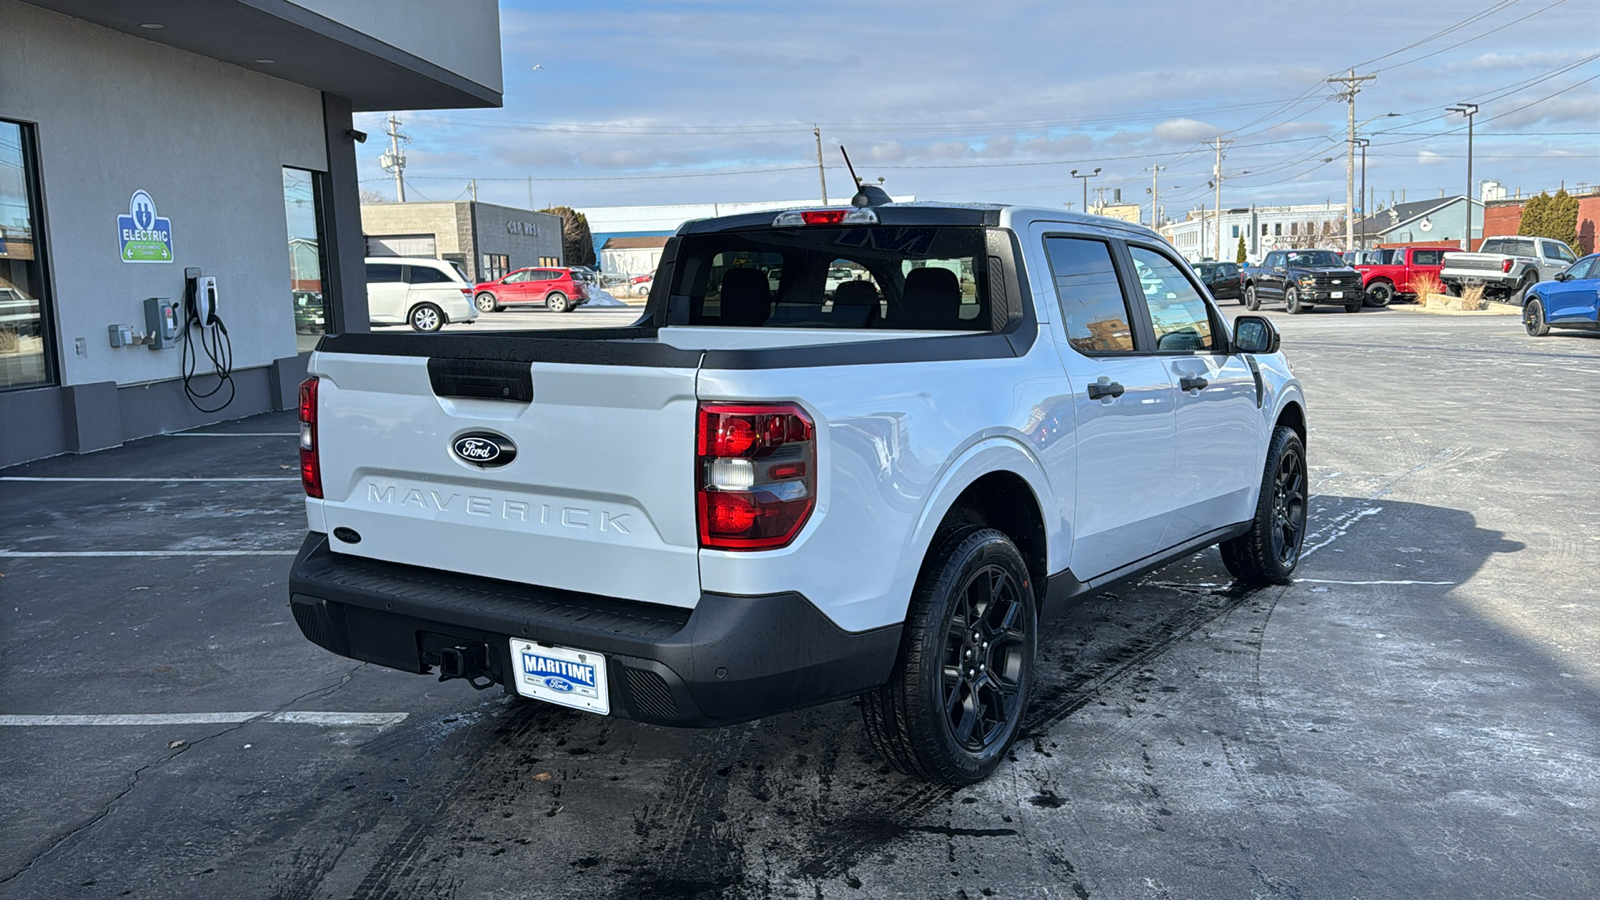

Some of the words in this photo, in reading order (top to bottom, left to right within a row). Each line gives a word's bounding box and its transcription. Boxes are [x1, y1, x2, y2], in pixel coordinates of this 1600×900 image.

[123, 228, 168, 242] ELECTRIC
[462, 440, 491, 458] Ford
[367, 483, 631, 534] MAVERICK
[523, 654, 594, 686] MARITIME
[549, 679, 569, 691] Ford
